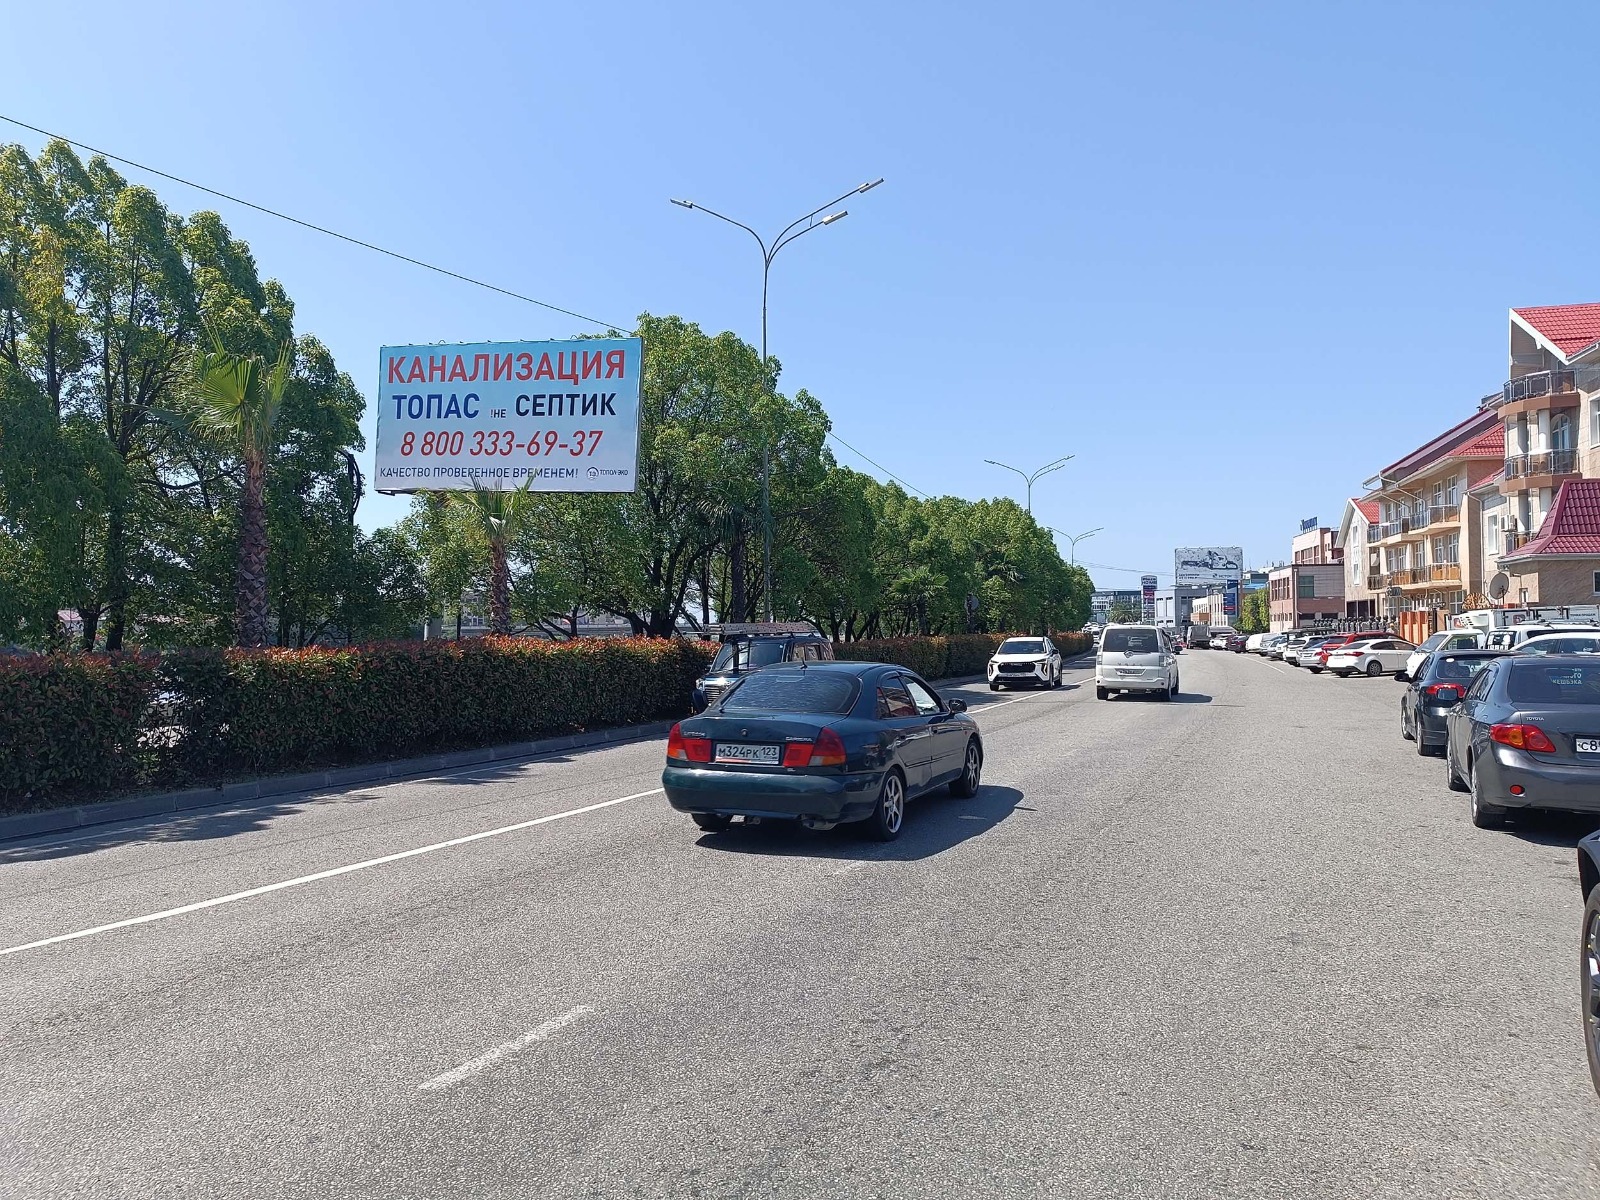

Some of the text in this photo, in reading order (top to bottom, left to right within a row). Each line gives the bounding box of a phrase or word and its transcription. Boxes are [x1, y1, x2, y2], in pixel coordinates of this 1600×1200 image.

[388, 350, 625, 385] КАНАЛИЗАЦИЯ
[392, 393, 480, 419] ТОПАС
[515, 392, 617, 417] СЕПТИК
[400, 430, 604, 457] 8 800 333-69-37
[380, 467, 579, 479] КАЧЕСТВО ПРОВЕРЕННОЕ ВРЕМЕНЕМ!
[761, 747, 777, 756] 123
